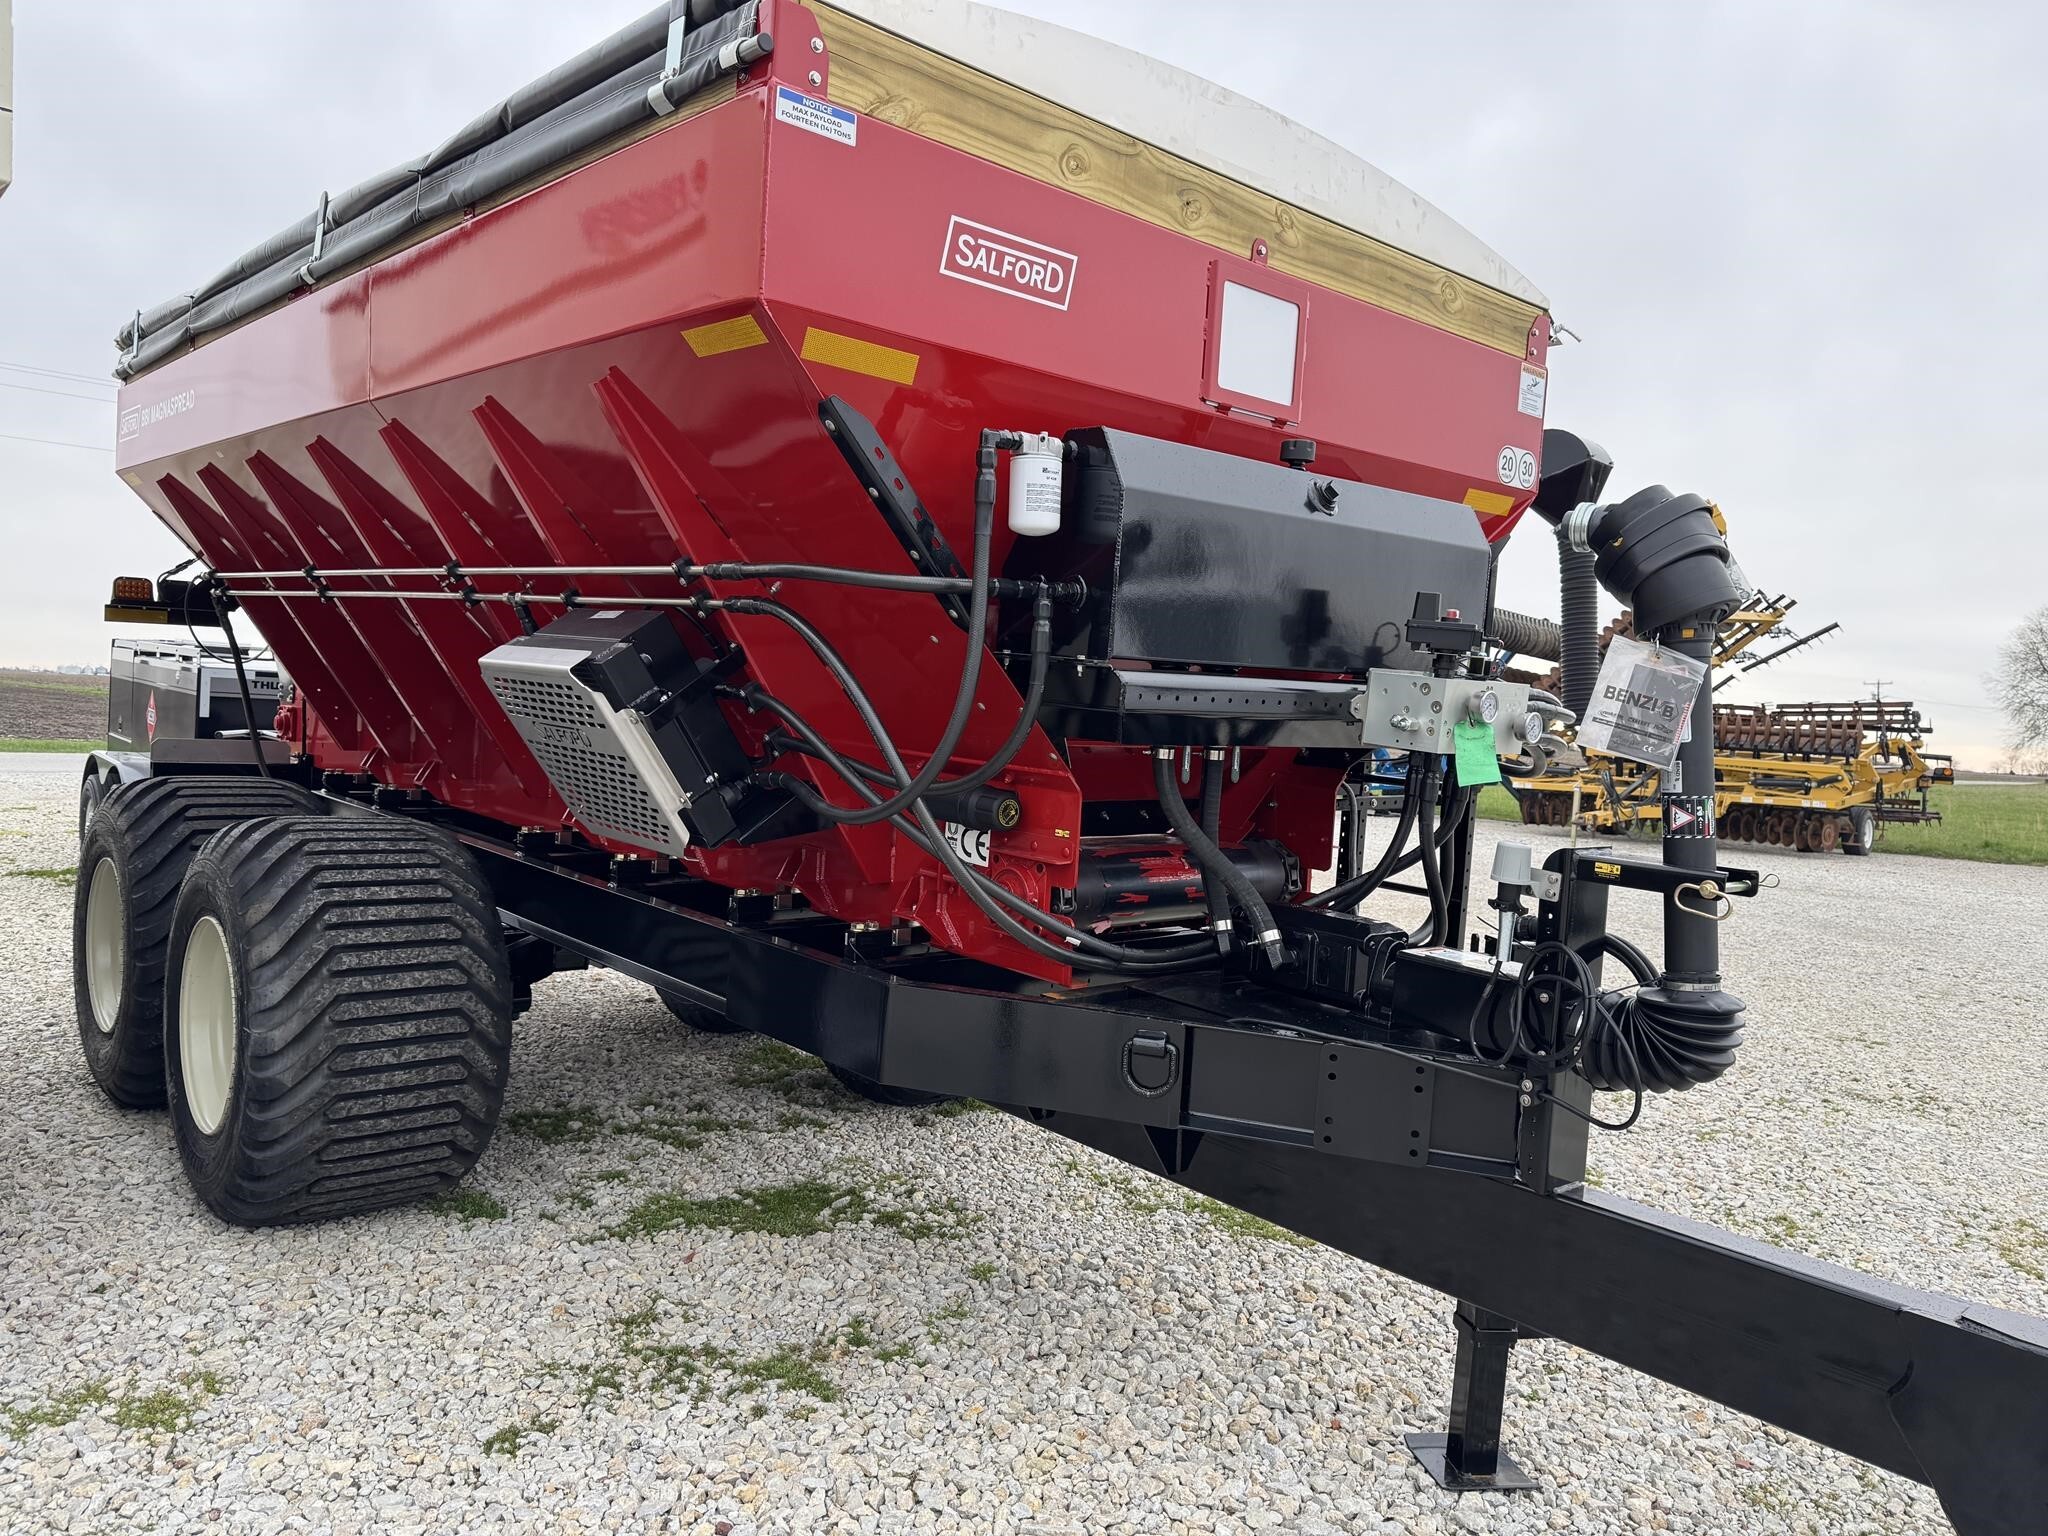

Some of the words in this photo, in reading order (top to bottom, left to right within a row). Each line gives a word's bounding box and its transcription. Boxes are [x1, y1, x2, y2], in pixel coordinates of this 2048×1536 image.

[792, 105, 809, 117] MAX
[810, 110, 842, 128] PAYLOAD
[802, 98, 833, 115] NOTICE
[781, 110, 819, 129] FOURTEEN
[820, 124, 832, 135] (14)
[833, 128, 852, 140] TONS
[955, 234, 1064, 293] SALFORD
[151, 389, 195, 424] MAGNASPREAD
[1501, 455, 1514, 473] 20
[1521, 460, 1533, 478] 30
[1603, 684, 1659, 712] BENZI
[532, 721, 592, 748] SALFORD
[961, 828, 989, 862] CE
